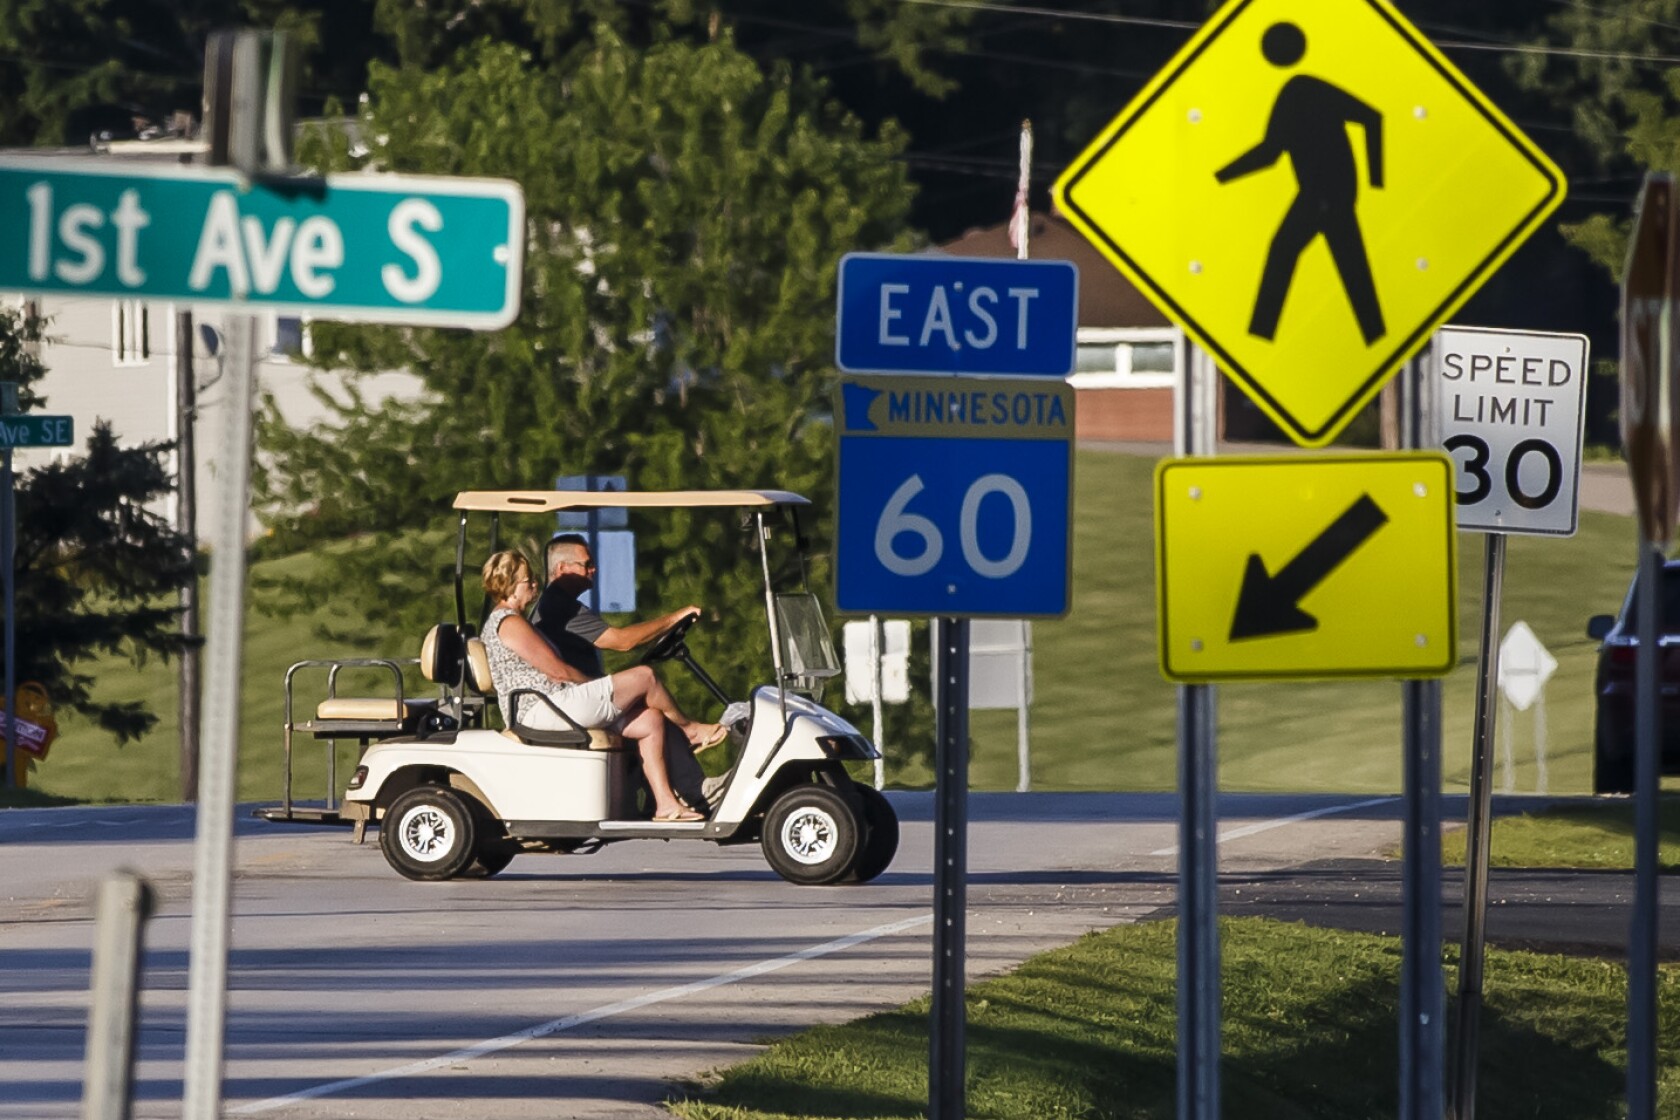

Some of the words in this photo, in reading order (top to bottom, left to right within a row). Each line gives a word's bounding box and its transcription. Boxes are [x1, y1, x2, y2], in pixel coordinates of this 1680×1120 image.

[27, 181, 151, 288] 1st
[188, 190, 345, 299] Ave
[381, 199, 443, 303] S
[878, 283, 1039, 350] EAST
[1442, 353, 1571, 387] SPEED
[41, 420, 68, 443] SE
[888, 391, 1066, 426] MINNESOTA
[1454, 394, 1554, 427] LIMIT
[1442, 434, 1563, 510] 30
[874, 473, 1033, 579] 60
